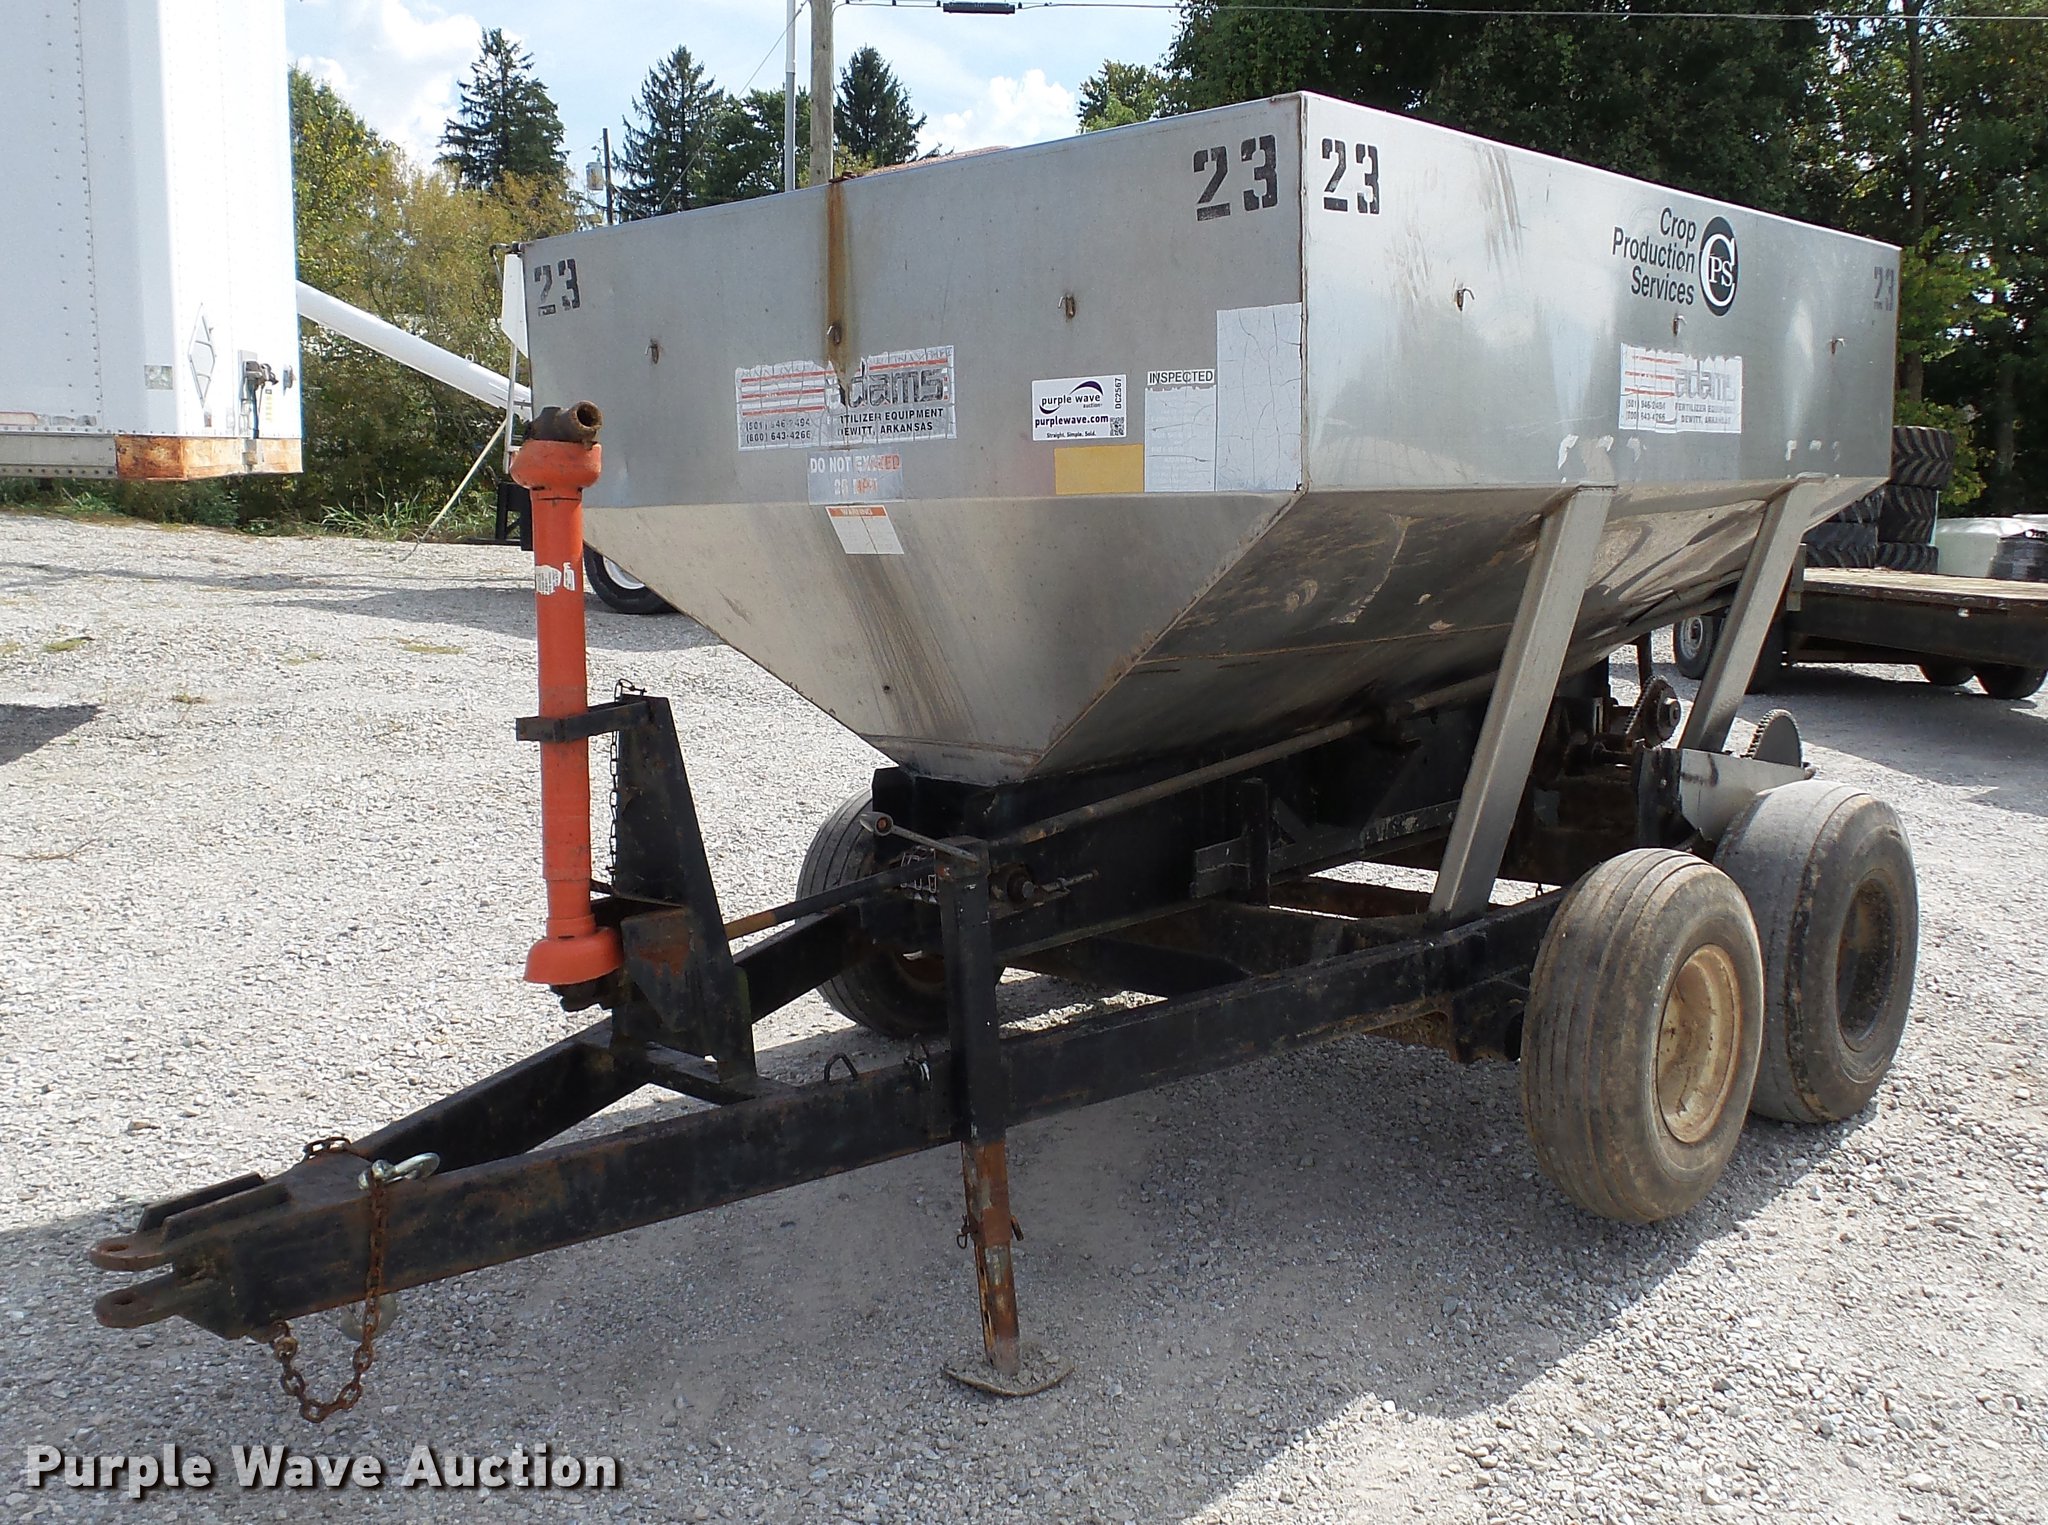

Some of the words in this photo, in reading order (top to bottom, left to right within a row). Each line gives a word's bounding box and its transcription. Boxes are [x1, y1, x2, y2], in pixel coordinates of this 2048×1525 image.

[1194, 134, 1279, 221] 23
[1322, 138, 1380, 215] 23
[1660, 207, 1696, 248] Crop
[1612, 226, 1695, 273] Production
[534, 258, 580, 316] 23
[1631, 265, 1694, 306] Services
[1872, 266, 1894, 311] 23
[838, 361, 944, 408] dams
[1113, 378, 1122, 409] DC2567
[1149, 370, 1214, 384] INSPECTED
[885, 408, 944, 421] EQUIPMENT
[1041, 395, 1072, 407] purple
[1075, 394, 1101, 403] wave
[880, 421, 933, 434] ARKANSAS
[1034, 415, 1109, 428] purplewave.com
[810, 457, 826, 473] DO
[829, 456, 852, 473] NOT
